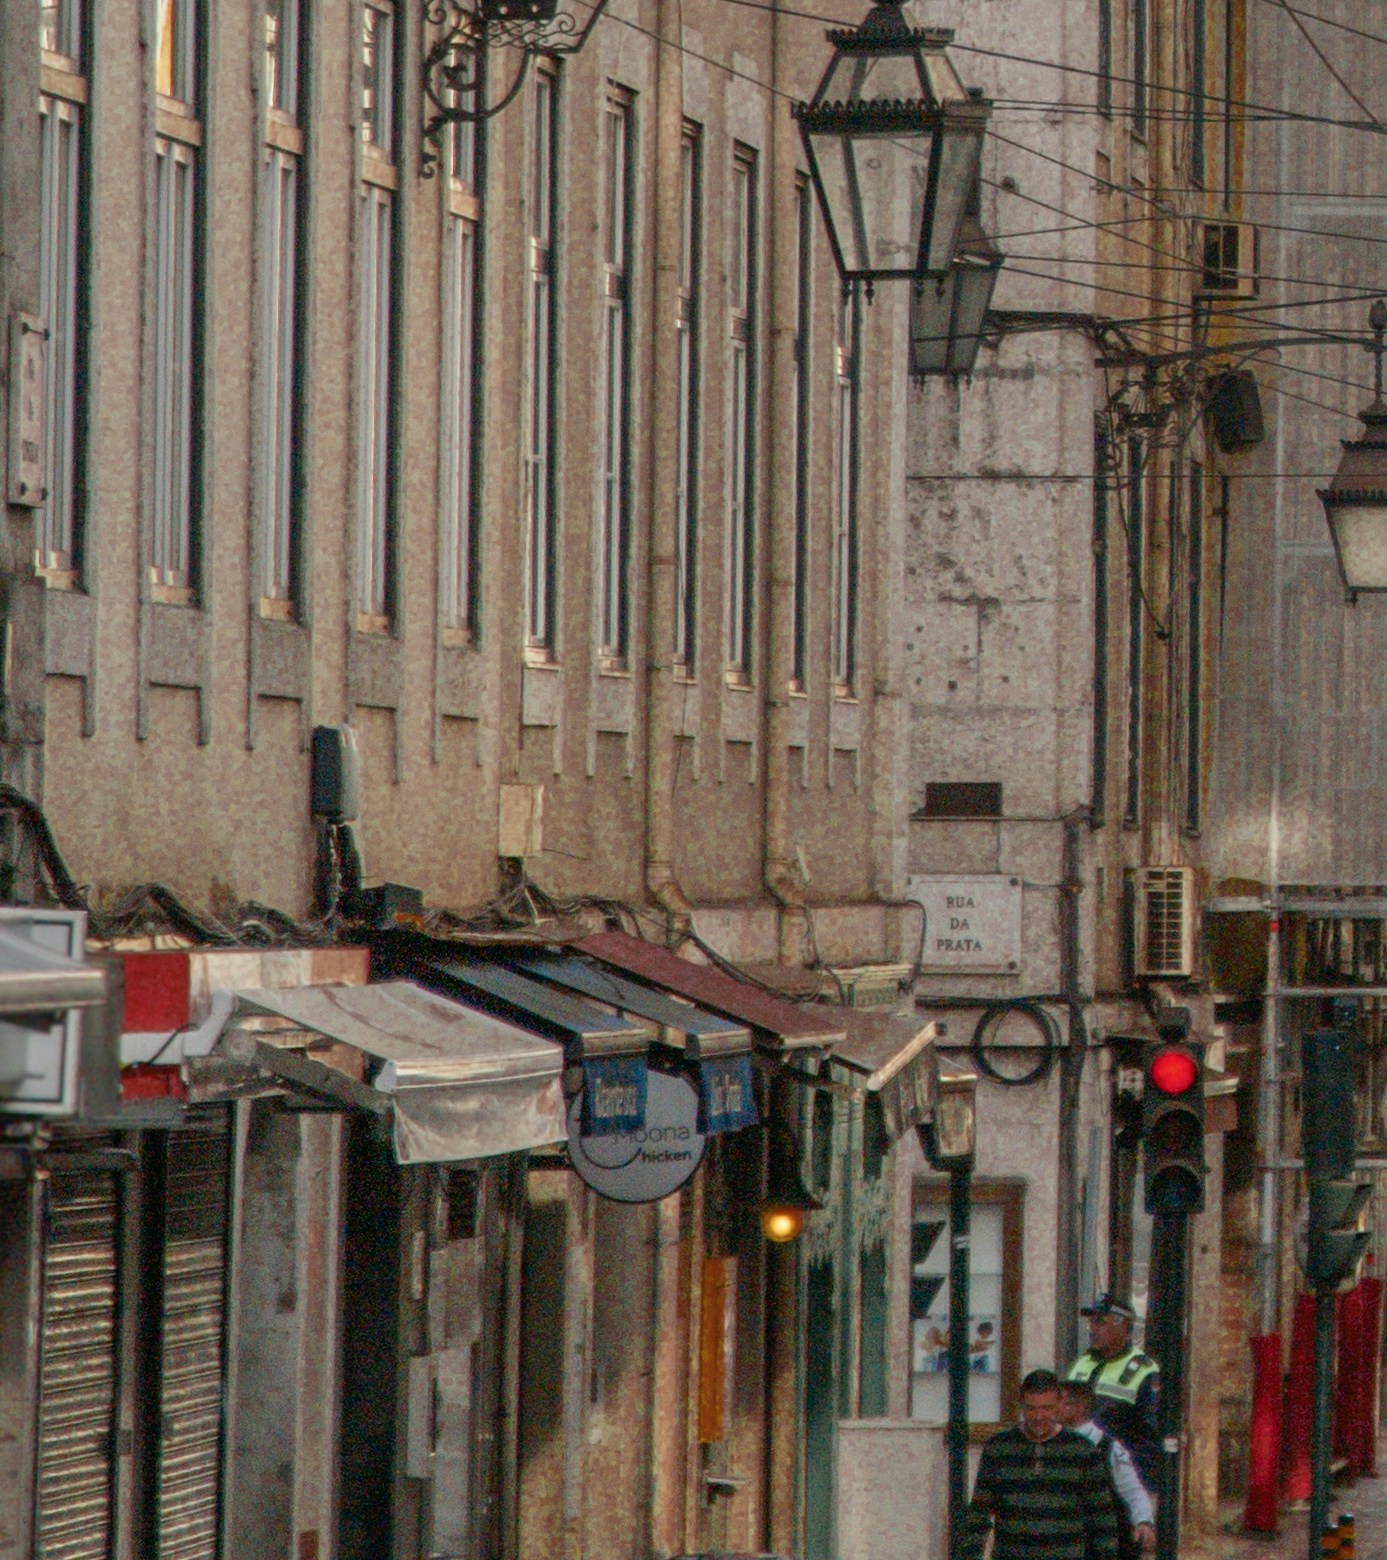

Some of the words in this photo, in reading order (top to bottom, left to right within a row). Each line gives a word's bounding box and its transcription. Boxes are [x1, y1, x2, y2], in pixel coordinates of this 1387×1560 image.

[946, 896, 976, 908] RUA
[950, 918, 970, 930] DA
[936, 938, 983, 952] PRATA
